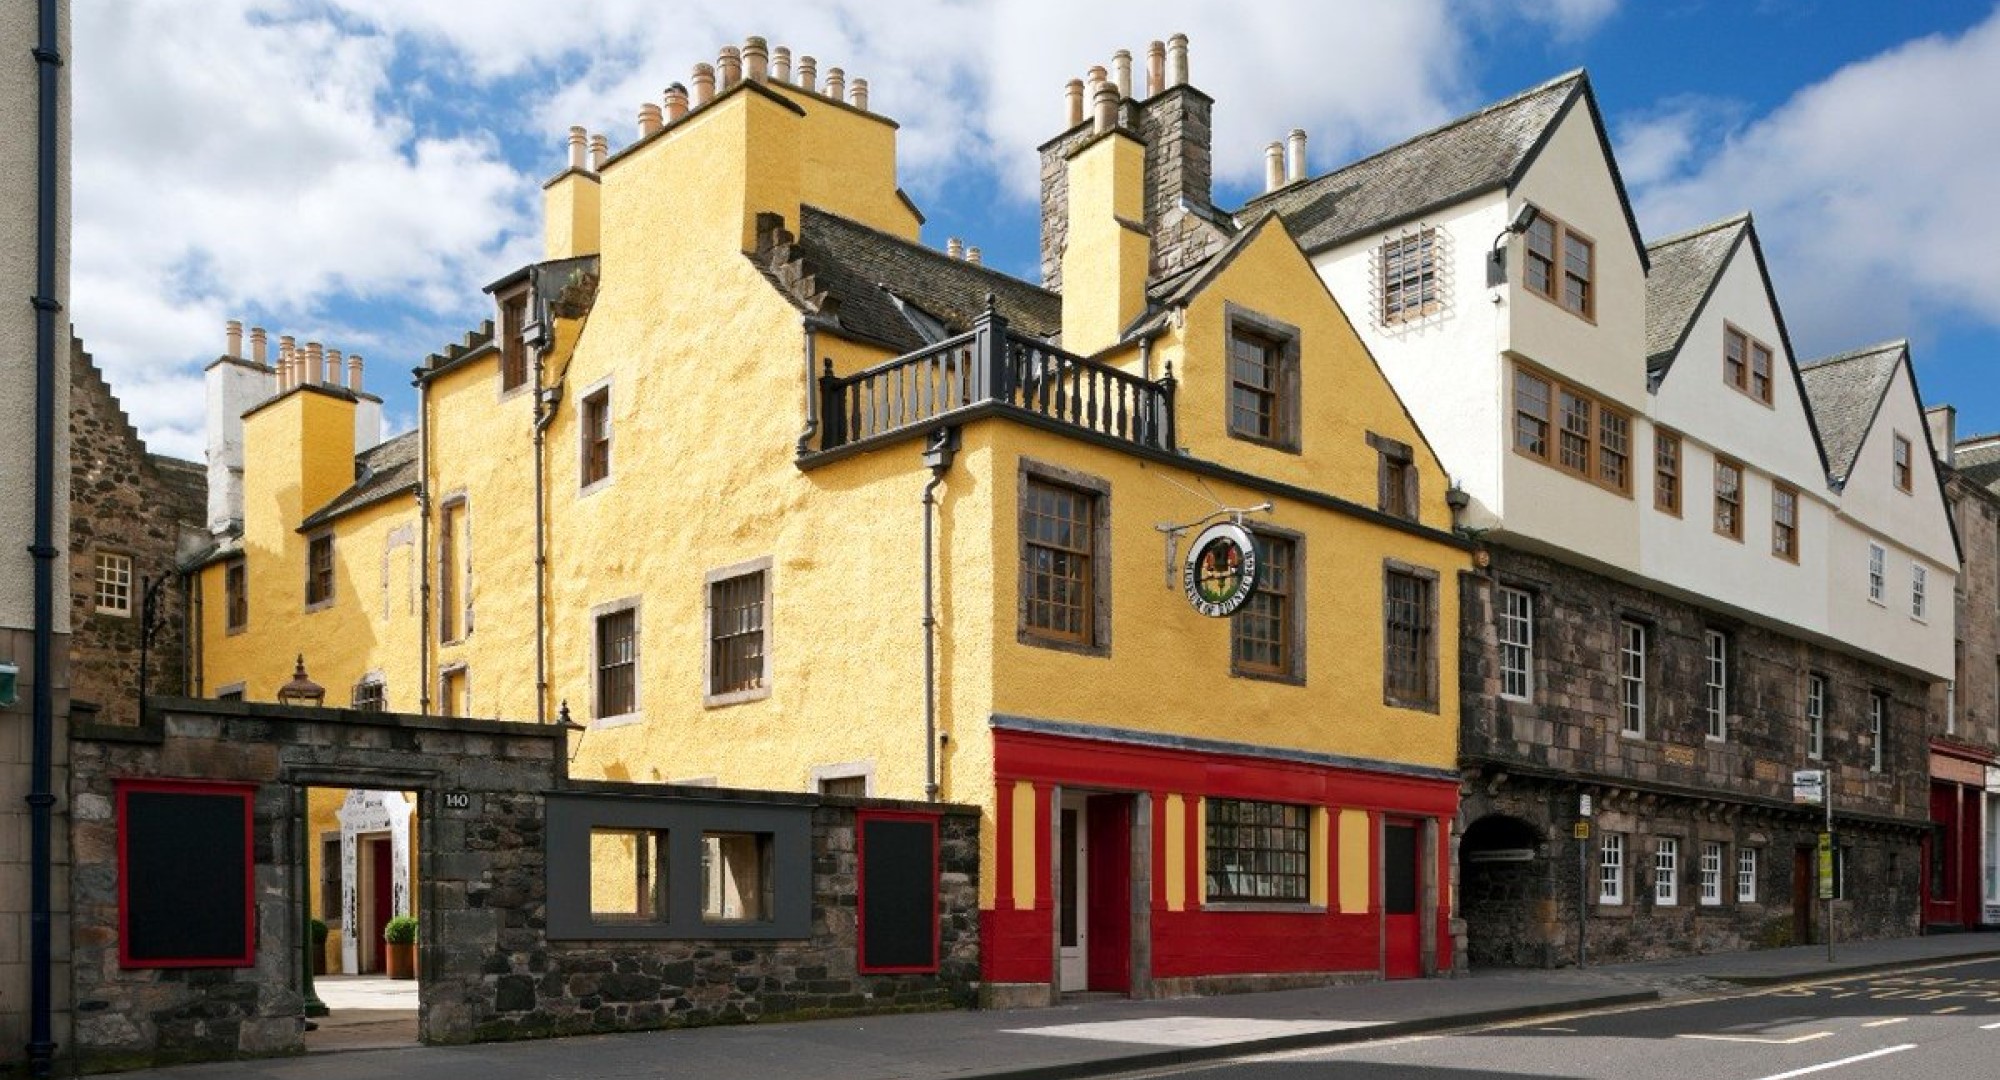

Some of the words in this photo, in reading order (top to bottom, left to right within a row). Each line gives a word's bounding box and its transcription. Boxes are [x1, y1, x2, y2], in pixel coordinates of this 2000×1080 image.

[1185, 562, 1204, 606] MUSEUM
[1219, 550, 1254, 614] EDINBURGH
[445, 794, 468, 807] 140
